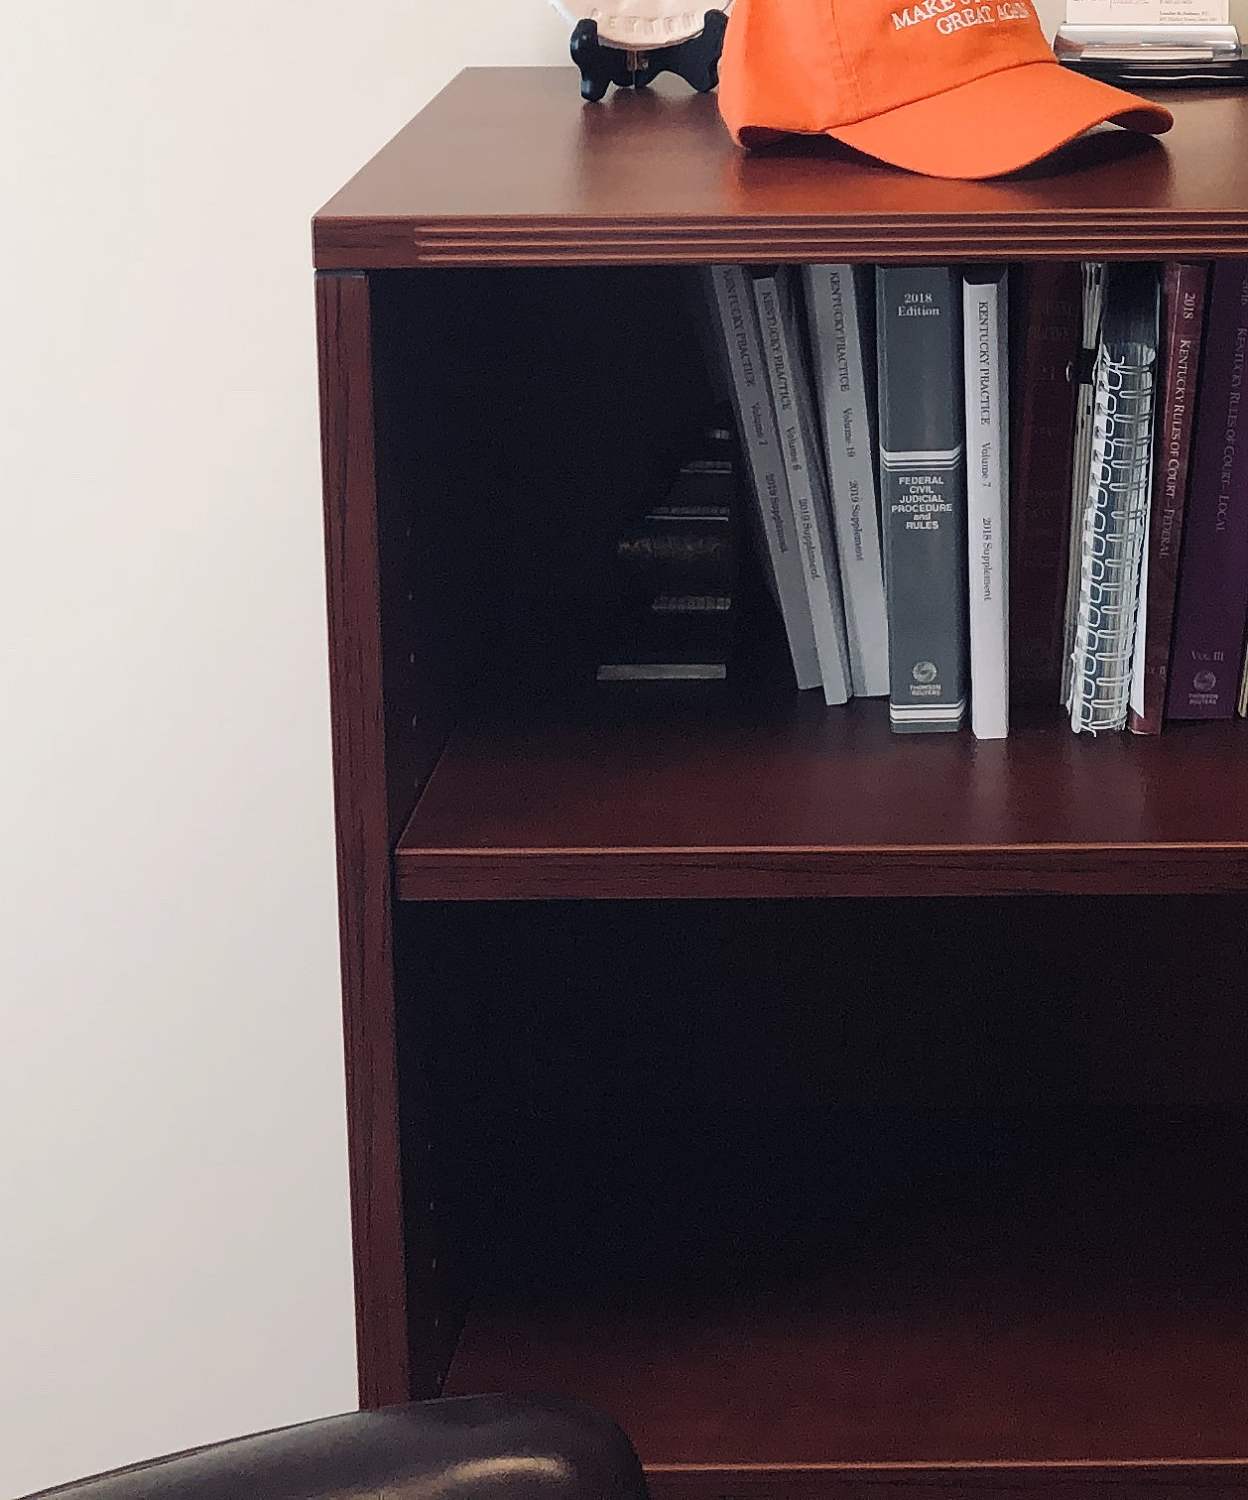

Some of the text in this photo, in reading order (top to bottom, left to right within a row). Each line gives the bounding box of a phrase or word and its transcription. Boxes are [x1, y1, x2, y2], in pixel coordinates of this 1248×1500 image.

[936, 5, 995, 35] GREAT
[830, 272, 845, 334] KENTUCKY
[898, 306, 940, 316] Edition
[904, 293, 933, 303] 2018
[1183, 291, 1196, 320] 2018
[979, 301, 990, 365] KENTUCKY
[774, 351, 793, 411] PRACTICE
[836, 335, 851, 393] PRACTICE
[1175, 339, 1191, 403] KENTUCKY
[980, 368, 991, 425] PRACTICE
[1227, 391, 1241, 428] RULES
[1171, 404, 1186, 441] RULES
[981, 442, 991, 479] Volume
[1169, 441, 1181, 458] OF
[899, 476, 945, 485] FEDERAL
[909, 486, 935, 494] CIVIL
[1165, 459, 1180, 499] COURT
[891, 504, 953, 513] PROCEDURE
[899, 494, 945, 503] JUDICIAL
[906, 521, 939, 530] RULES
[981, 542, 993, 601] Supplement
